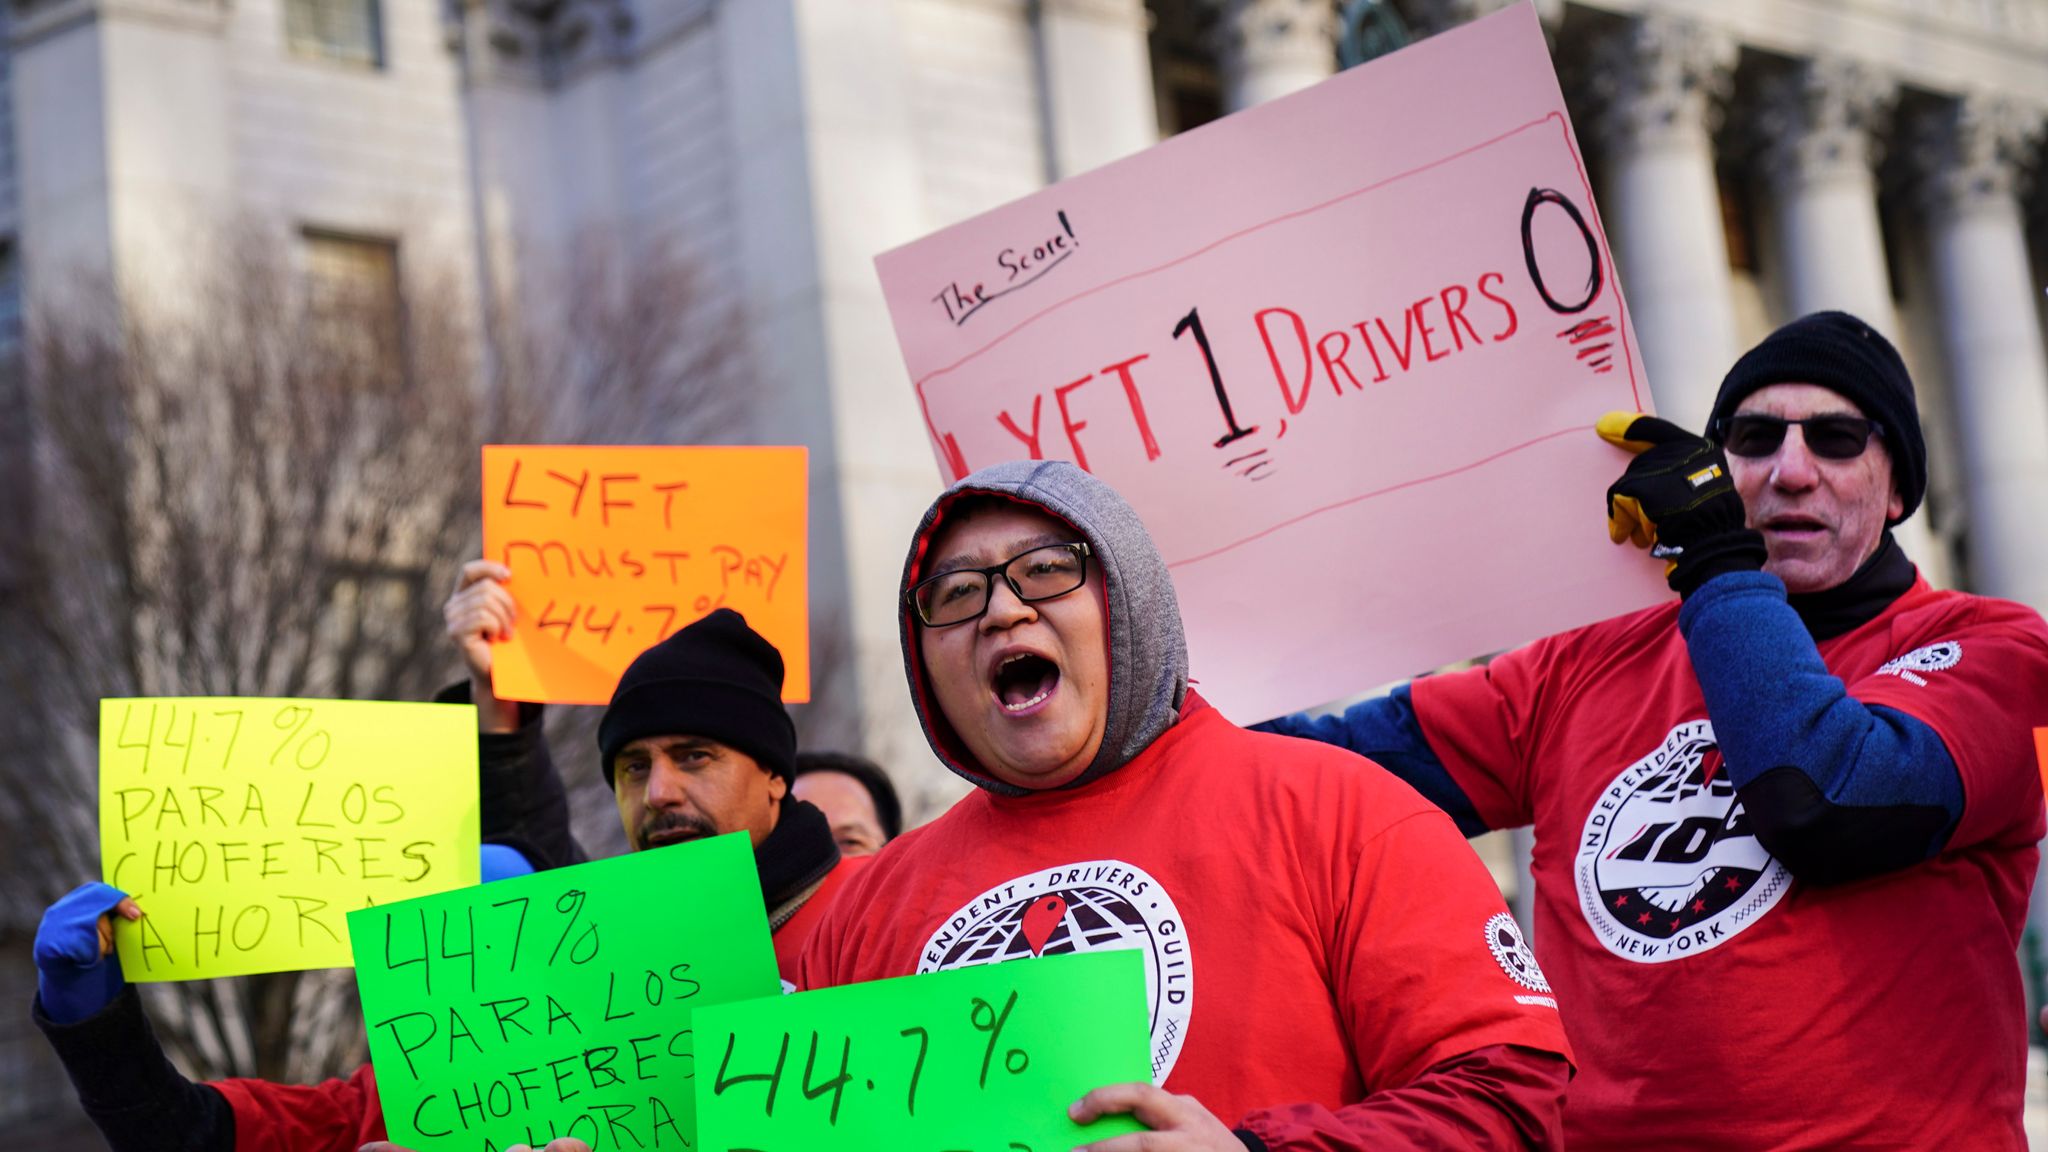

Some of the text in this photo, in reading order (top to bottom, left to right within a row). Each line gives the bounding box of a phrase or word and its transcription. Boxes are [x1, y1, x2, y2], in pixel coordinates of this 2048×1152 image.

[932, 209, 1081, 322] The Score!
[504, 458, 690, 531] LYFT
[710, 544, 789, 604] PAY
[1900, 669, 1928, 688] UNION
[114, 782, 405, 842] PARA LOS
[1582, 723, 1707, 857] INDEPENDENT
[113, 837, 435, 899] CHOFERES
[138, 893, 376, 973] AHOR
[921, 865, 1187, 1006] ENDENT DRIVERS GUILD
[1615, 920, 1726, 958] NEW YORK
[374, 962, 701, 1081] PARA LOS
[483, 1096, 691, 1152] HORA
